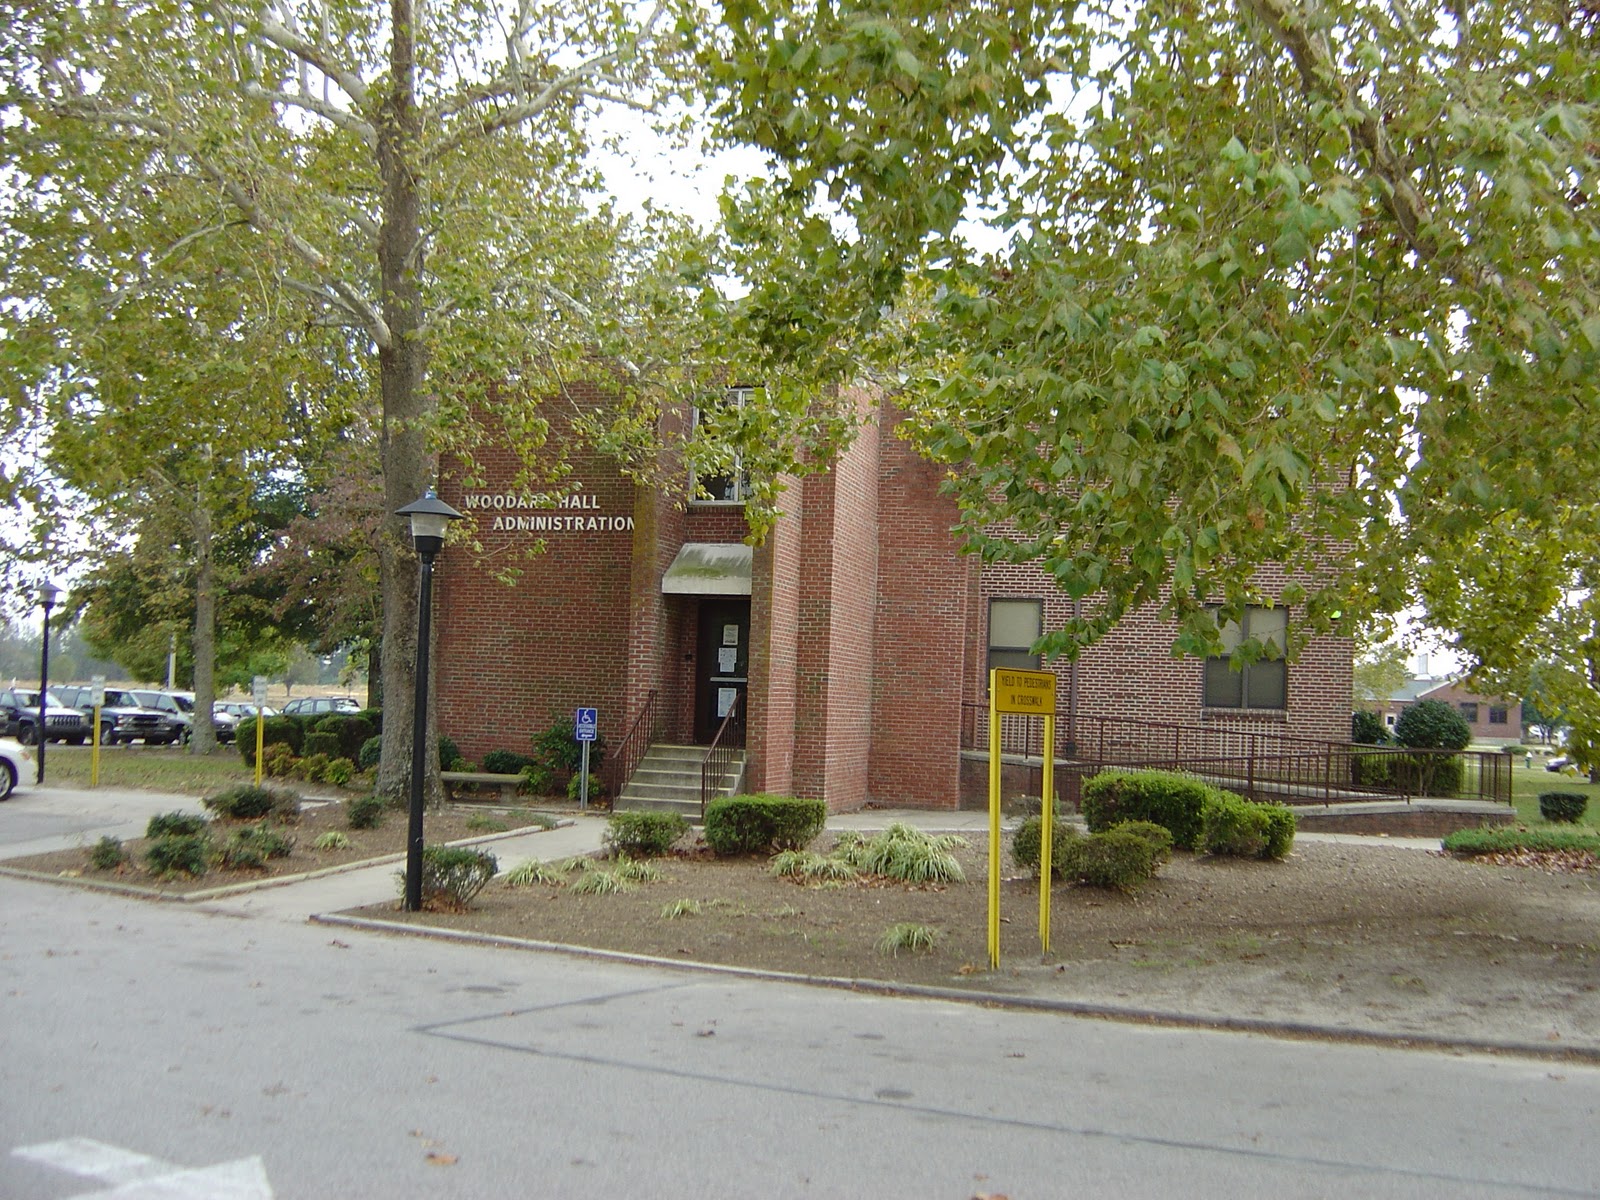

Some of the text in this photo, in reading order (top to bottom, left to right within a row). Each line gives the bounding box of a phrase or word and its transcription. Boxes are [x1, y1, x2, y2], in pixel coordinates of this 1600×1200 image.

[558, 494, 601, 509] HALL
[493, 516, 635, 531] ADMINISTRATION
[1001, 675, 1015, 687] YIELD
[1016, 676, 1023, 688] TO
[1010, 694, 1016, 705] IN
